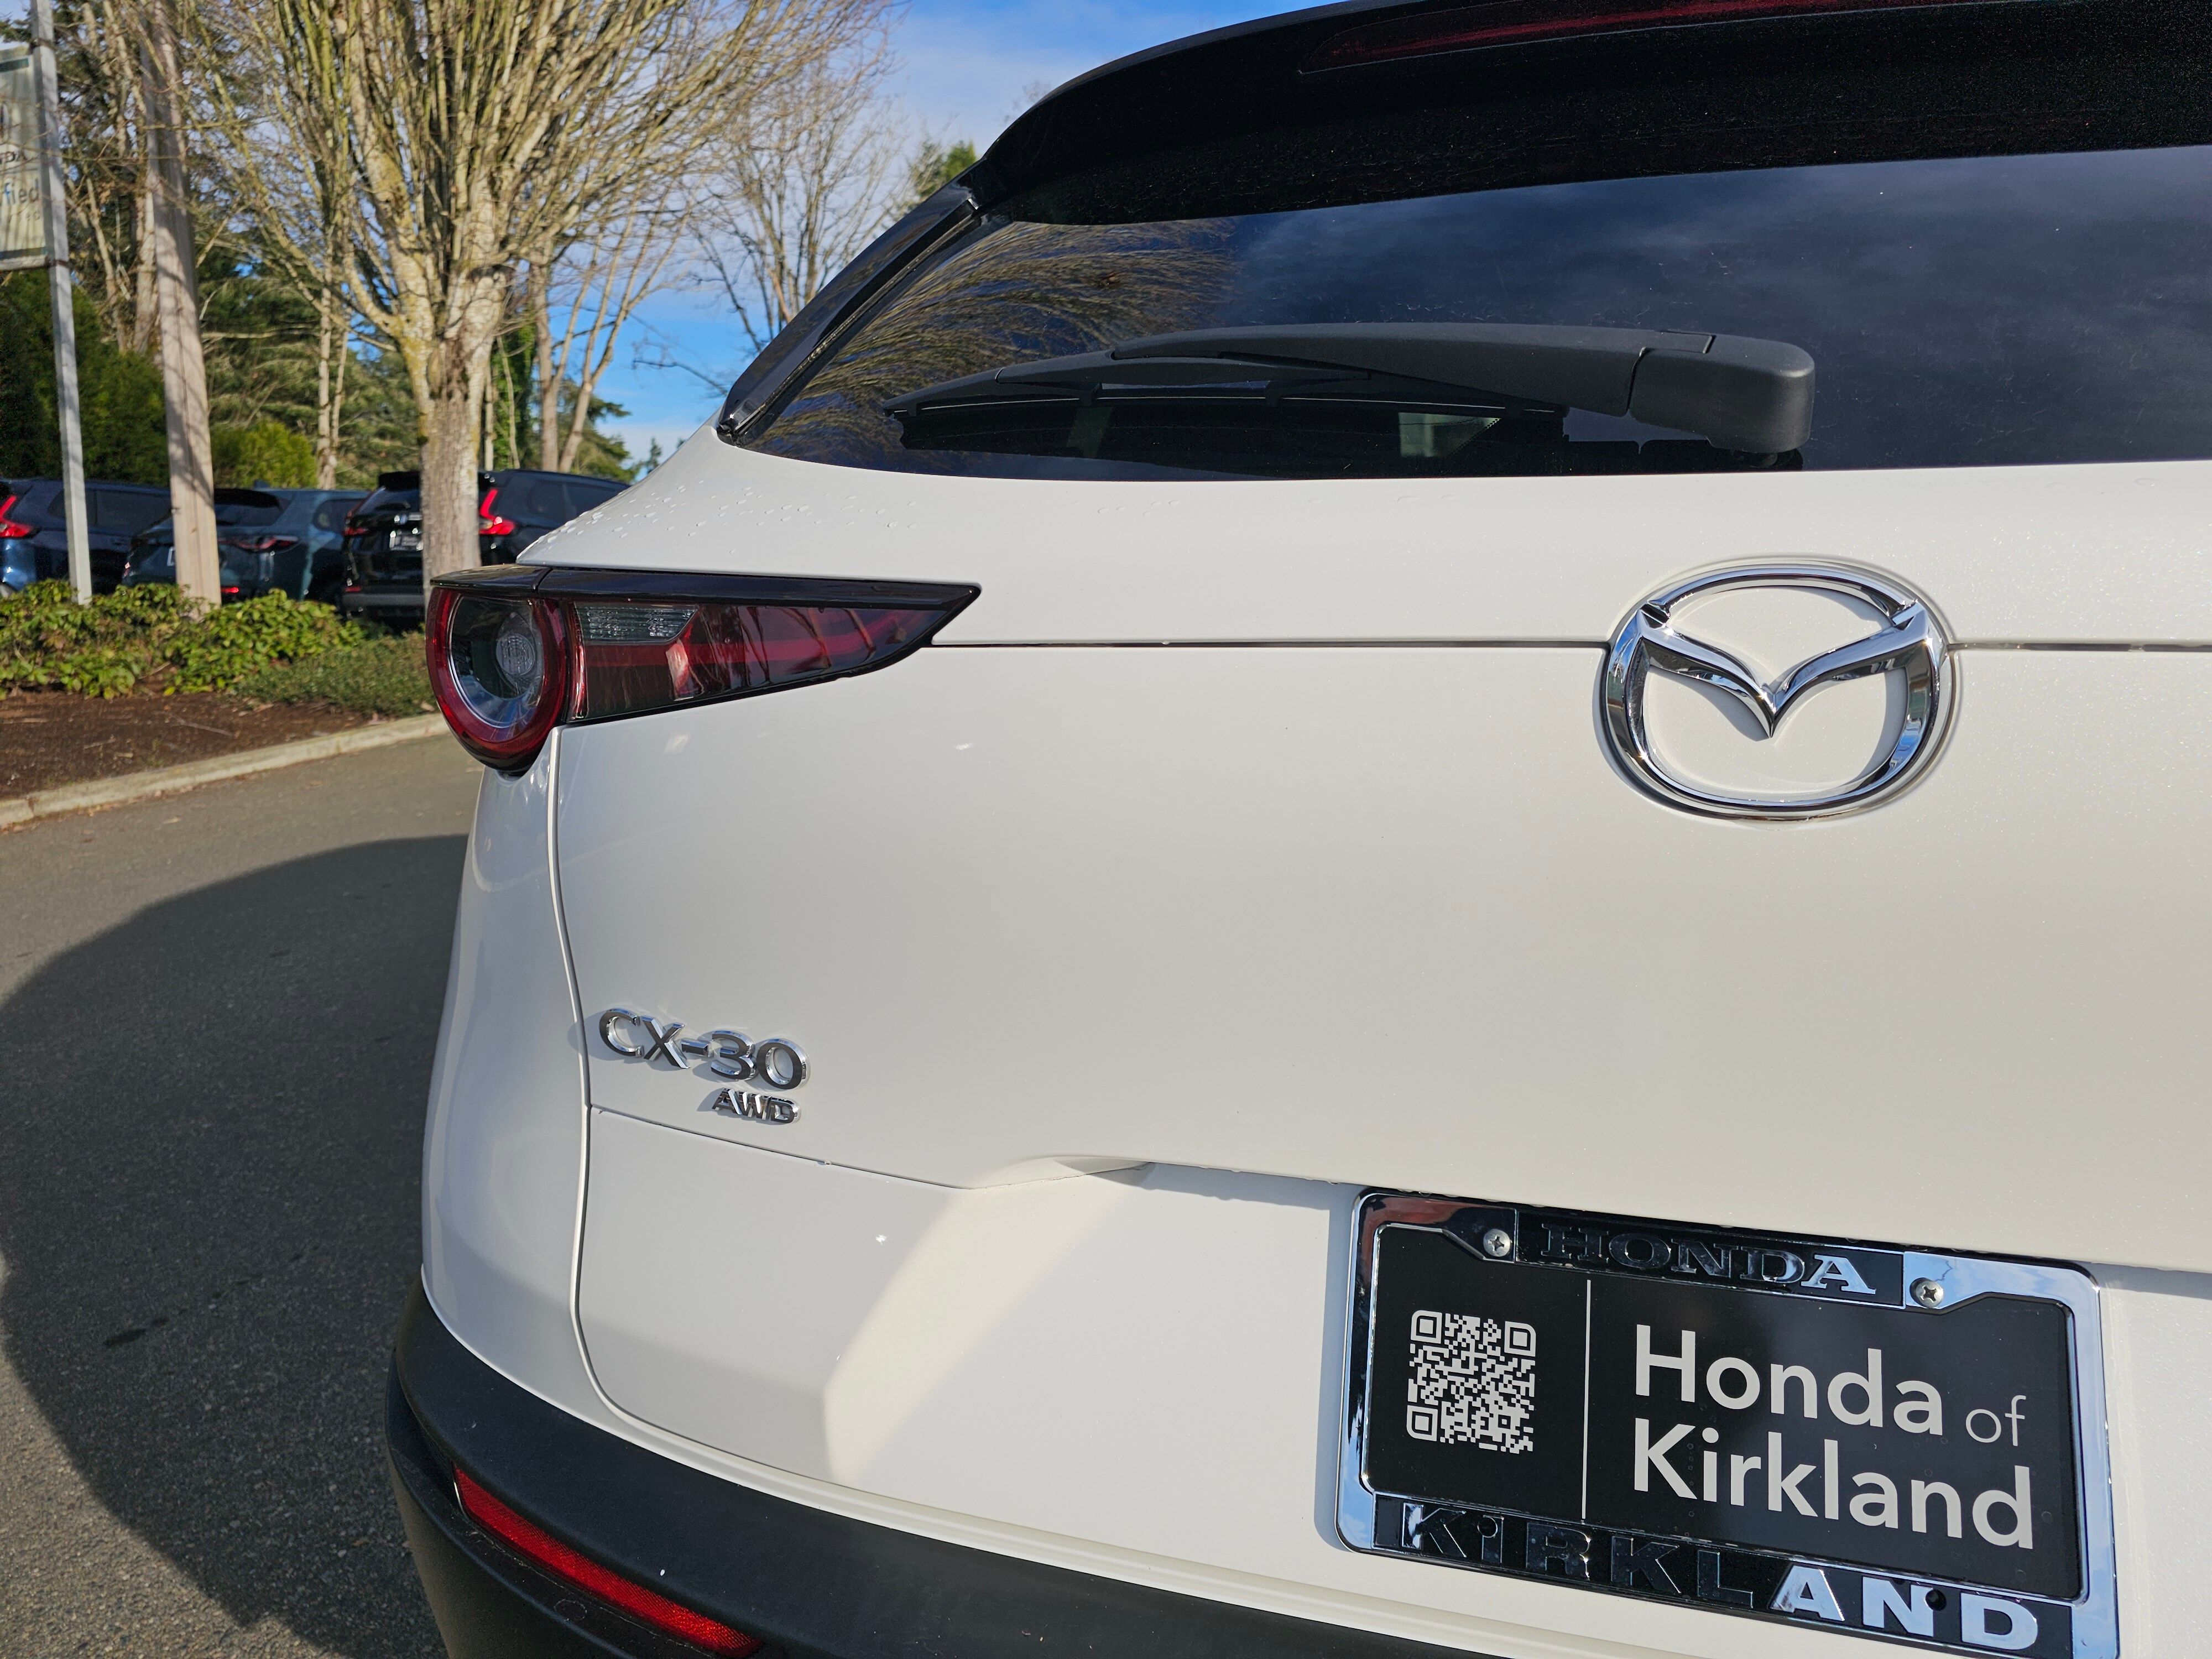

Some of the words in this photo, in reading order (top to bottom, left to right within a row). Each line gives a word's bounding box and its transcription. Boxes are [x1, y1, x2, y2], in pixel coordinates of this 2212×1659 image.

[599, 1007, 810, 1090] CX-30
[711, 1087, 800, 1124] AWD
[1540, 1223, 1876, 1296] HONDA
[1636, 1324, 1943, 1436] Honda
[1965, 1395, 2026, 1447] of
[1634, 1417, 2033, 1550] Kirkland
[1402, 1501, 2038, 1651] KIRKLAND
